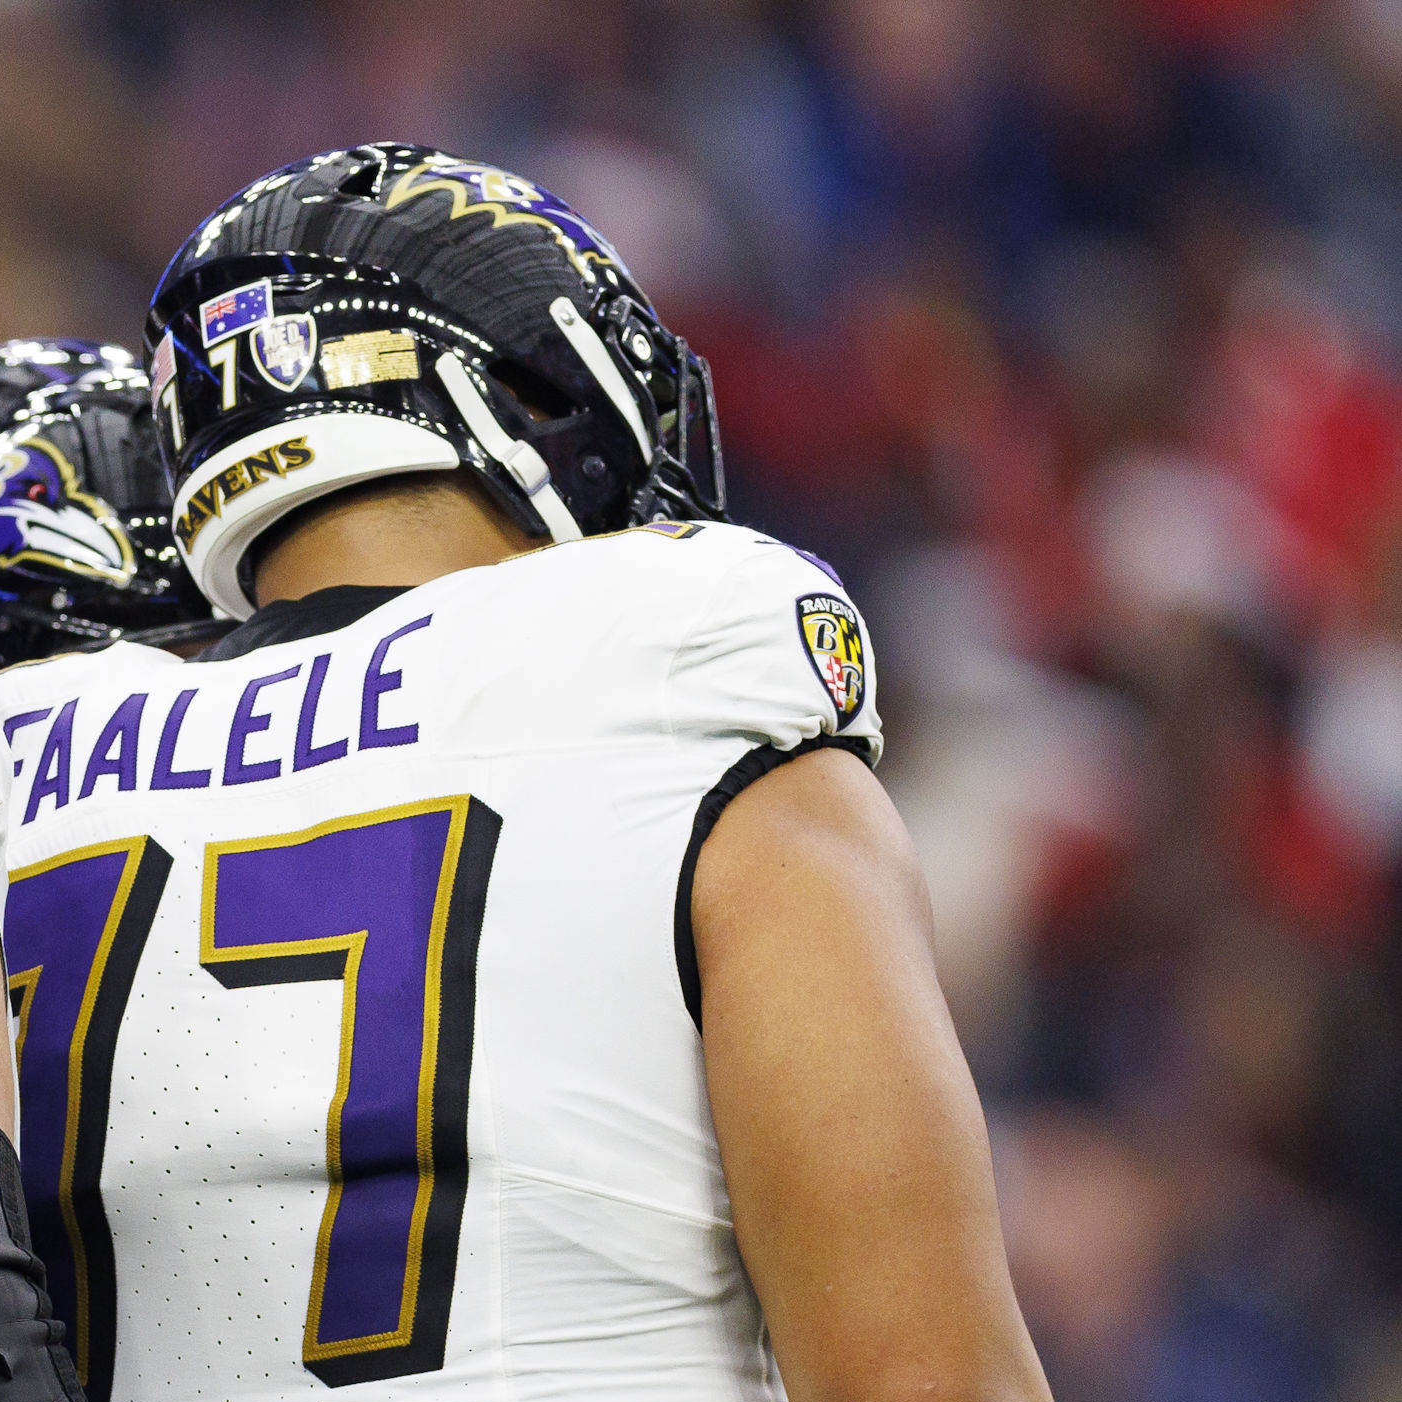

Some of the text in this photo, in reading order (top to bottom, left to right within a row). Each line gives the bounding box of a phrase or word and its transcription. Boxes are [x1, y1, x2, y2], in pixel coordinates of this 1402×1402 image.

[208, 339, 237, 410] 7
[800, 597, 856, 624] RAVENS
[2, 612, 434, 826] FAALELE
